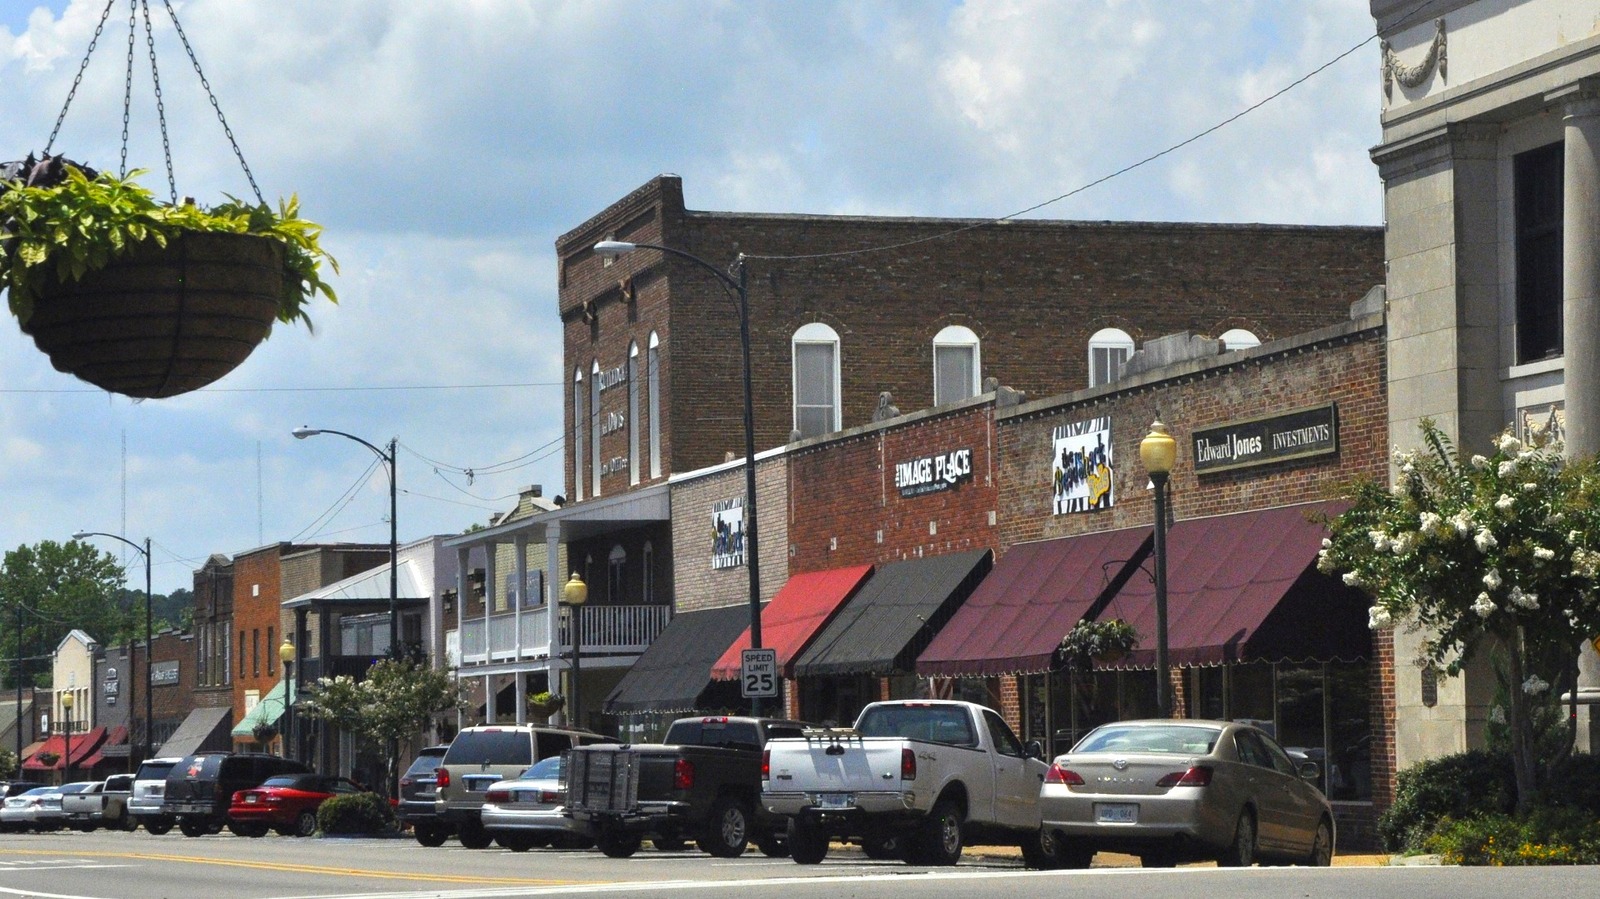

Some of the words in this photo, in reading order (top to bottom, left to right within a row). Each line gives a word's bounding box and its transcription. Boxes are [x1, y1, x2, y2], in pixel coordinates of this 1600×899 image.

[1197, 435, 1231, 462] Edward
[1233, 434, 1262, 460] Jones
[1273, 424, 1329, 450] INVESTMENTS
[900, 458, 932, 487] IMAGE
[935, 449, 970, 483] PLACE
[745, 654, 773, 662] SPEED
[748, 664, 769, 672] LIMIT
[746, 674, 773, 692] 25
